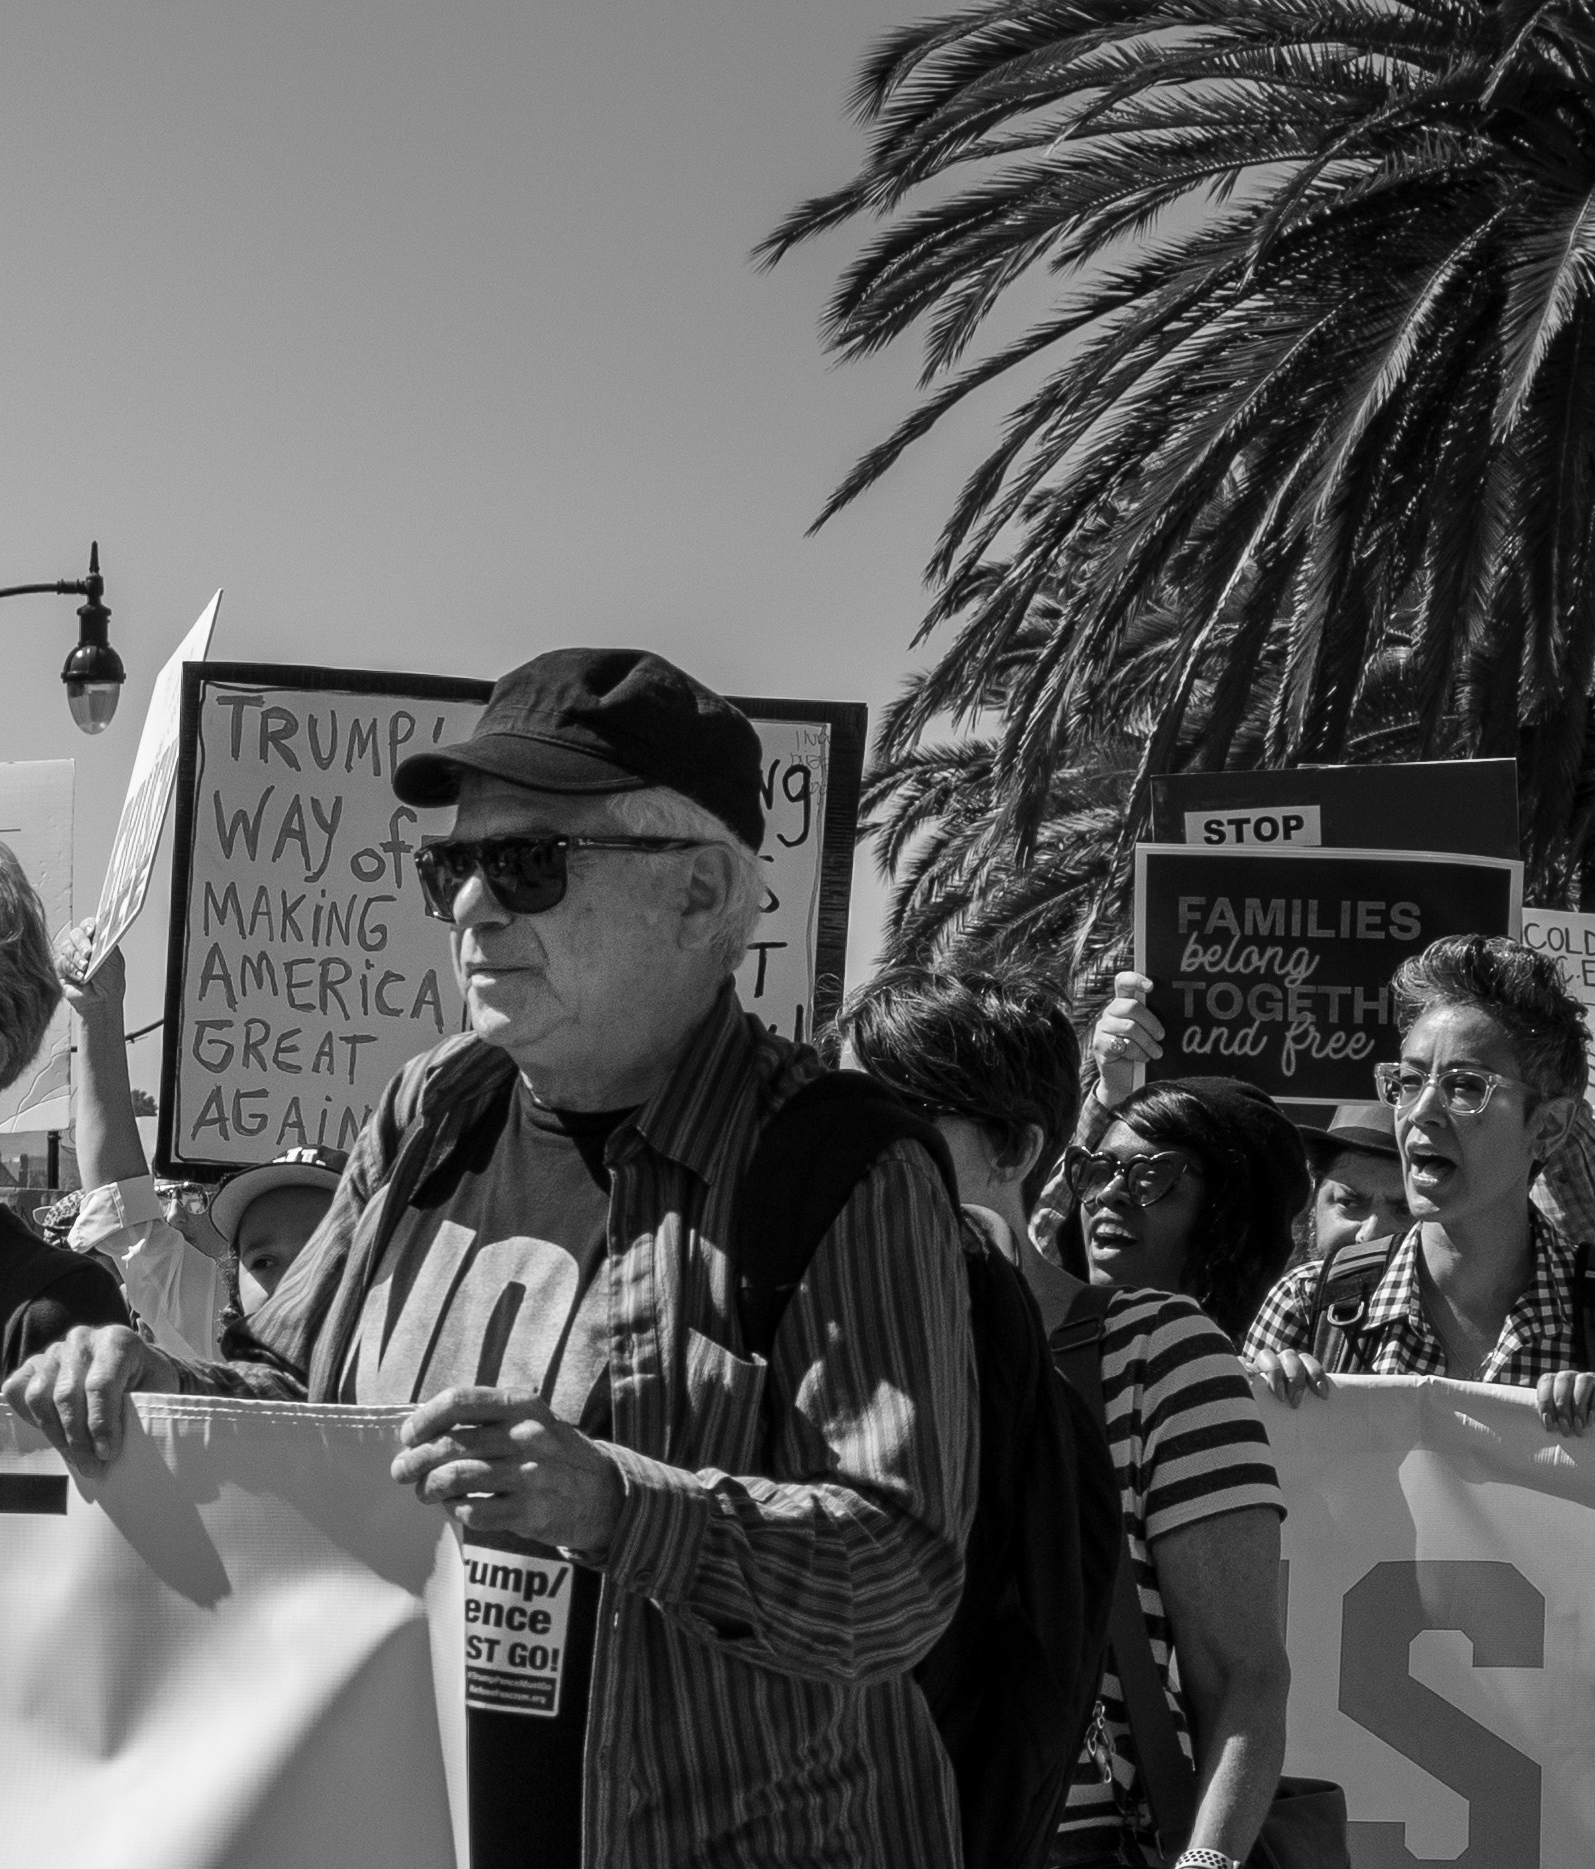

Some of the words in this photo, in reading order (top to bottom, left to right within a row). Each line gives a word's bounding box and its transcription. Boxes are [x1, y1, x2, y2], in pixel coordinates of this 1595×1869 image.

[213, 784, 344, 884] WAY
[349, 805, 419, 890] of
[1202, 813, 1306, 846] STOP
[202, 880, 398, 952] MAKING
[1177, 895, 1424, 942] FAMILIES
[197, 942, 445, 1035] AMERICA
[1179, 930, 1321, 989] belong
[1171, 980, 1401, 1026] TOGETH
[191, 1017, 379, 1085] GREAT
[1181, 1019, 1269, 1056] and
[1281, 1011, 1375, 1078] free
[508, 1642, 560, 1673] GO!
